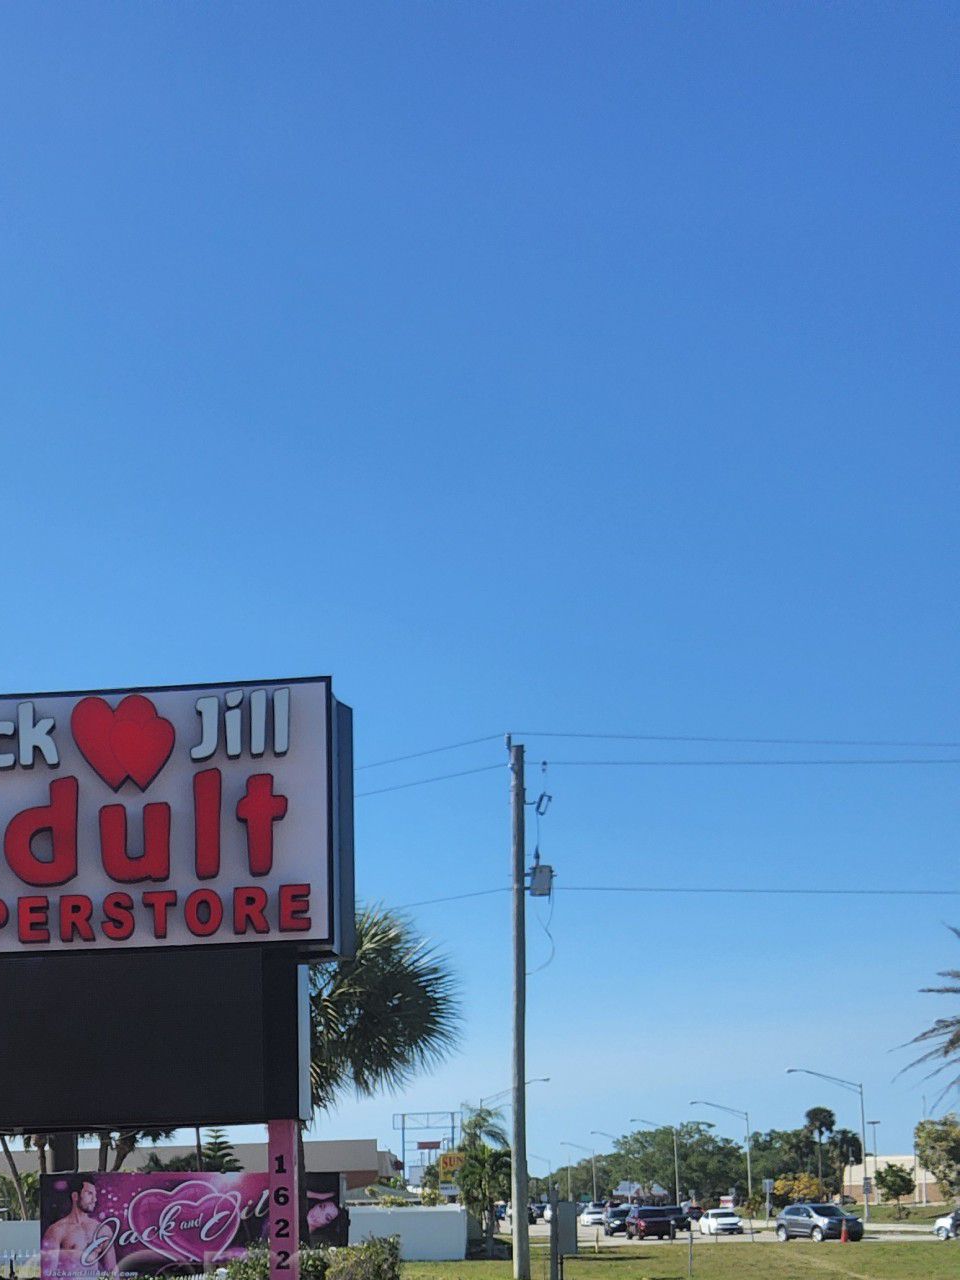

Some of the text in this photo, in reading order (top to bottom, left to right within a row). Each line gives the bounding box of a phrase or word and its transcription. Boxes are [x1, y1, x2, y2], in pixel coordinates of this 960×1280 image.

[189, 687, 290, 762] Jill
[80, 1204, 182, 1266] Jack
[179, 1212, 203, 1231] and
[273, 1154, 291, 1270] 1622
